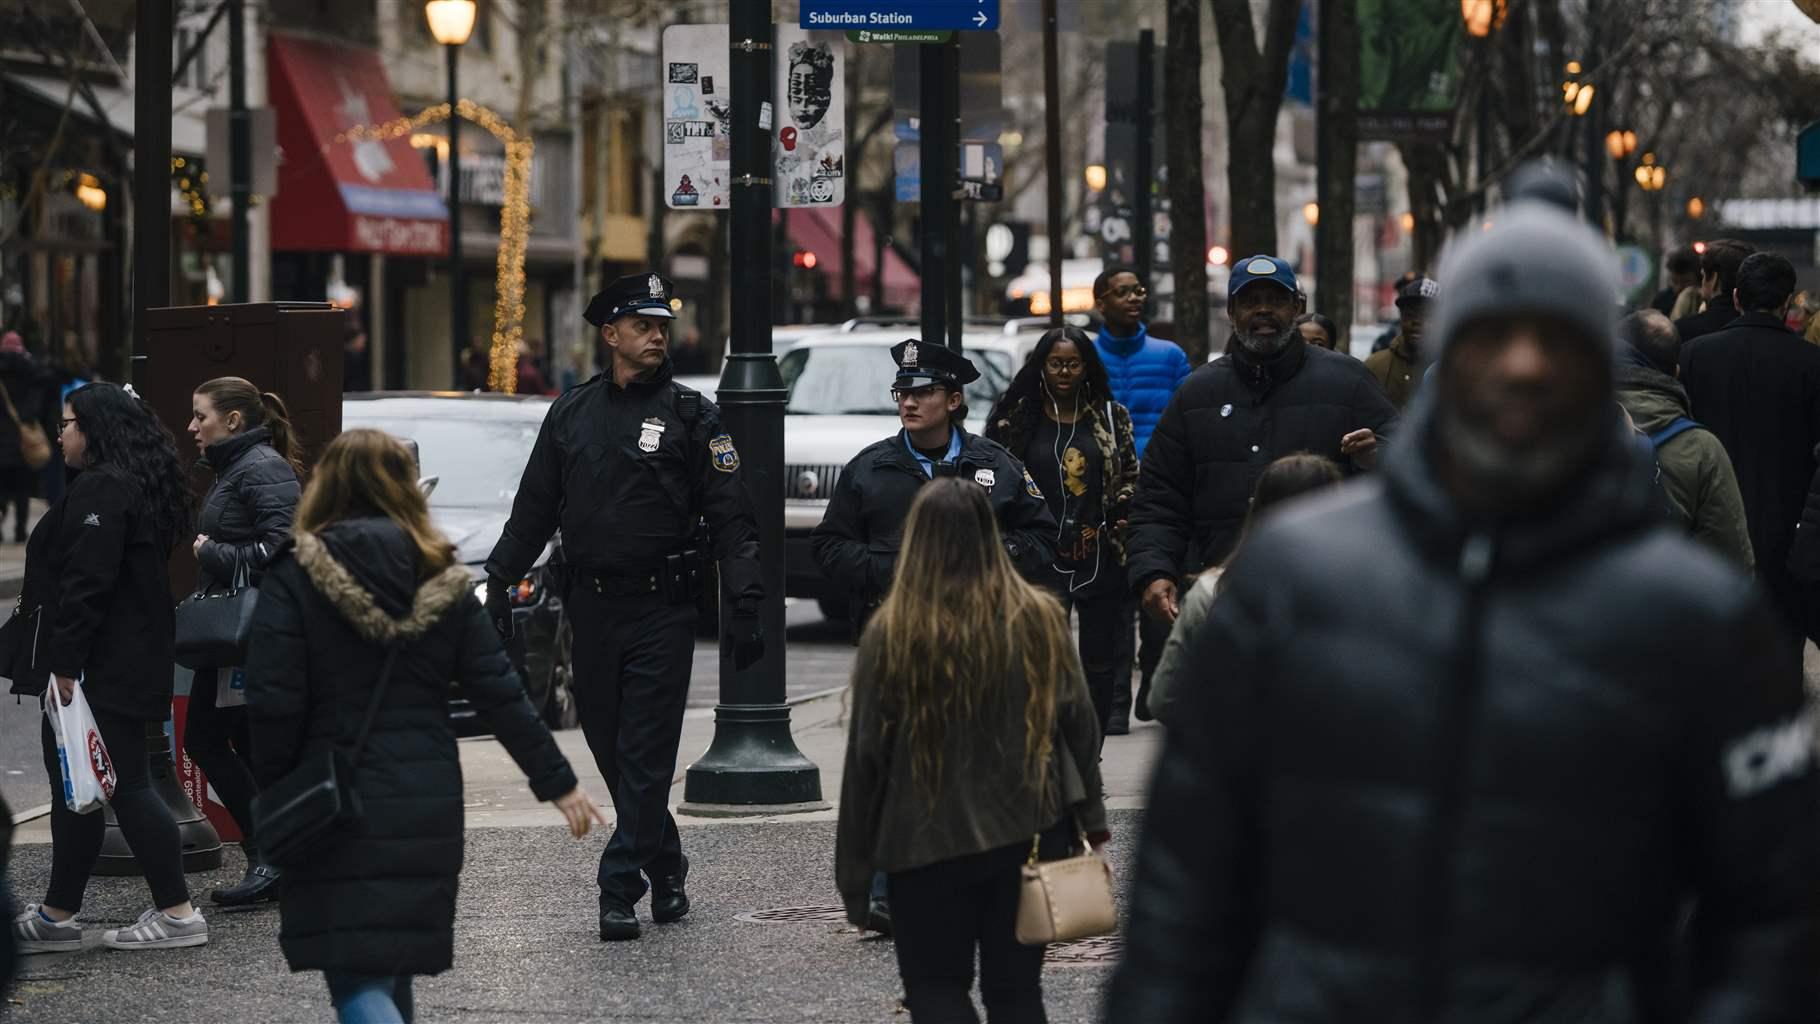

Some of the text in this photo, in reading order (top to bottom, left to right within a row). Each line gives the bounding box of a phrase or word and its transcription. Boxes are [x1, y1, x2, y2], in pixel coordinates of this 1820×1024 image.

[809, 12, 913, 24] Suburban Station
[872, 33, 893, 41] Walk!
